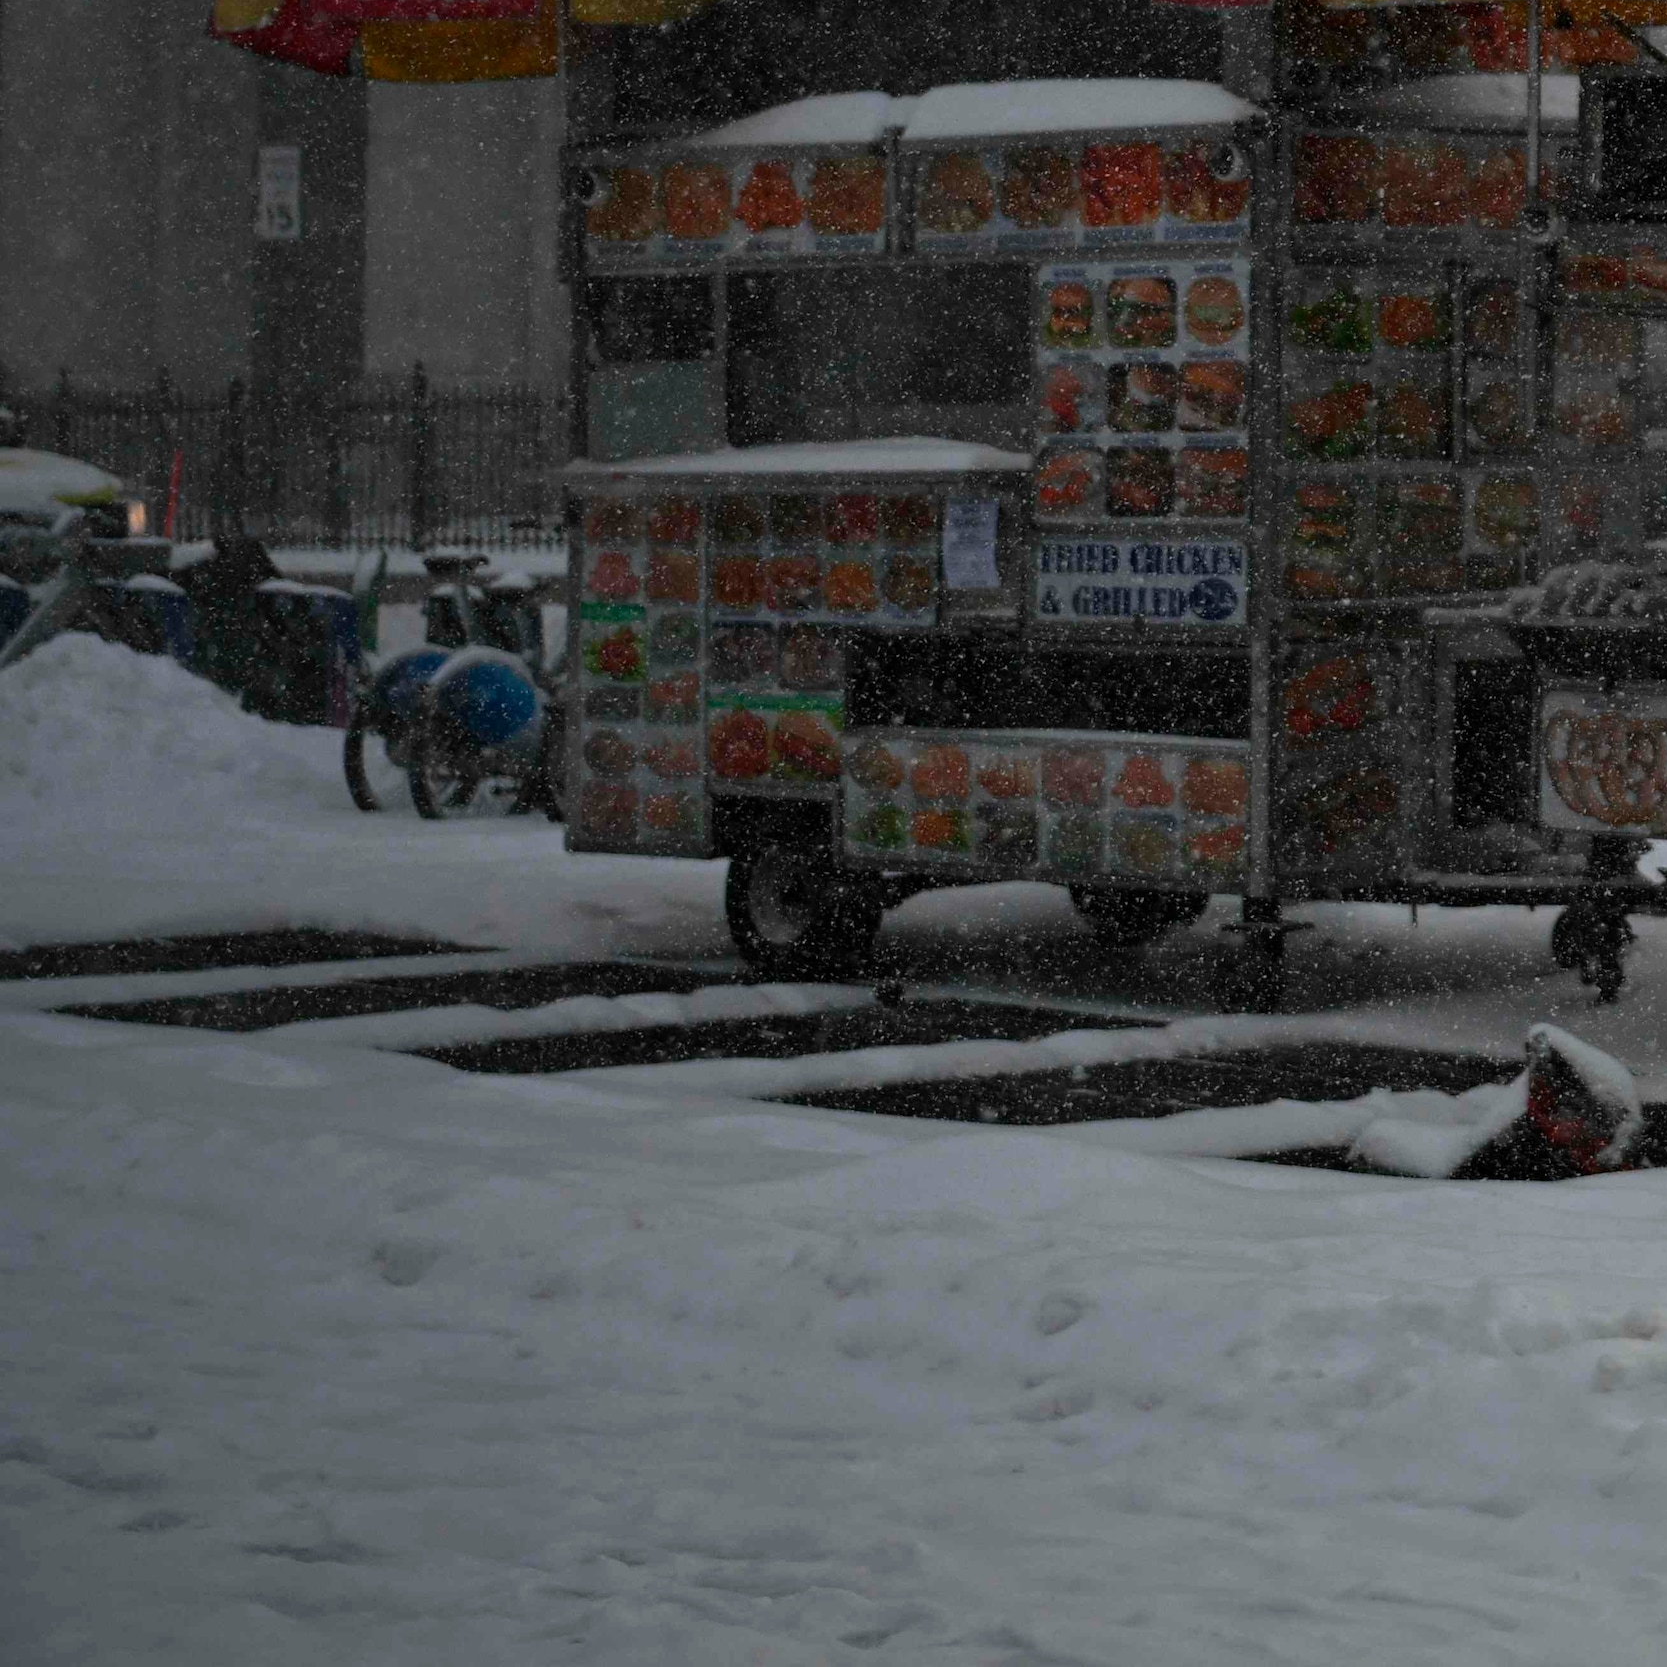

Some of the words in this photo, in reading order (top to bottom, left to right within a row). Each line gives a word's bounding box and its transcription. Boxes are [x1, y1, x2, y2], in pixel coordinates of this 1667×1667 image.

[1041, 543, 1119, 574] FRIED
[1129, 543, 1244, 575] CHICKEN
[1071, 585, 1189, 617] GRILLED
